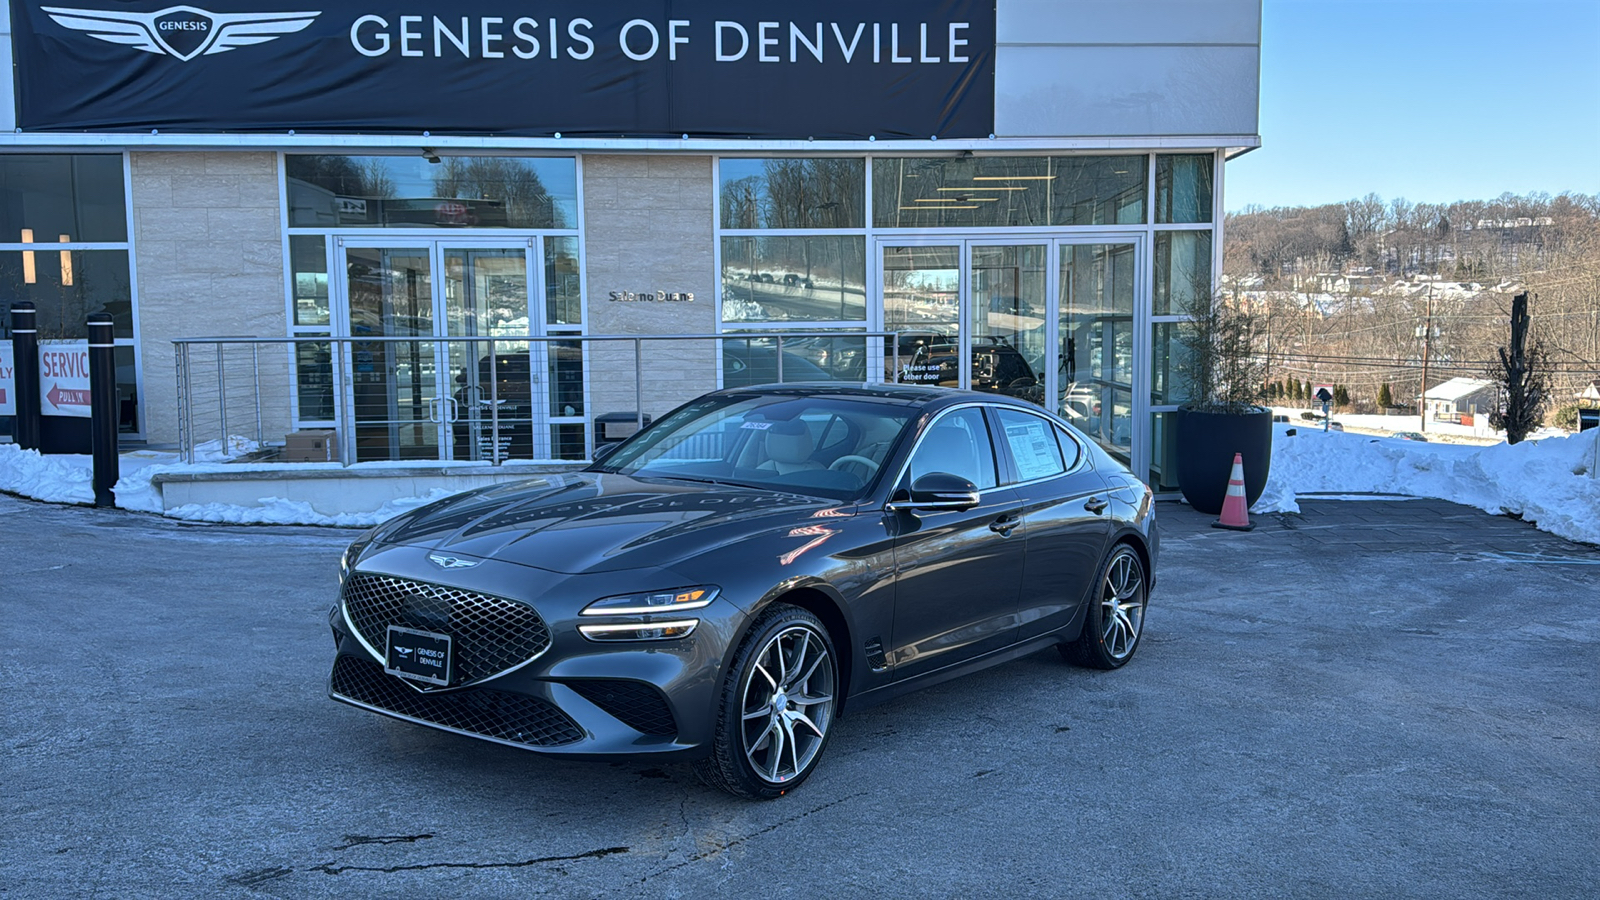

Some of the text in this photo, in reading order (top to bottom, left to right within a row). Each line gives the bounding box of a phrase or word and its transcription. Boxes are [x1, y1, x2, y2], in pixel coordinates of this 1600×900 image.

[159, 21, 207, 31] GENESIS
[350, 14, 970, 64] GENESIS OF DENVILLE
[608, 289, 694, 302] Salerno Duane
[43, 351, 89, 378] SERVIC
[59, 391, 84, 403] PULL IN
[417, 647, 437, 658] GENESIS
[420, 657, 442, 667] DENVILLE
